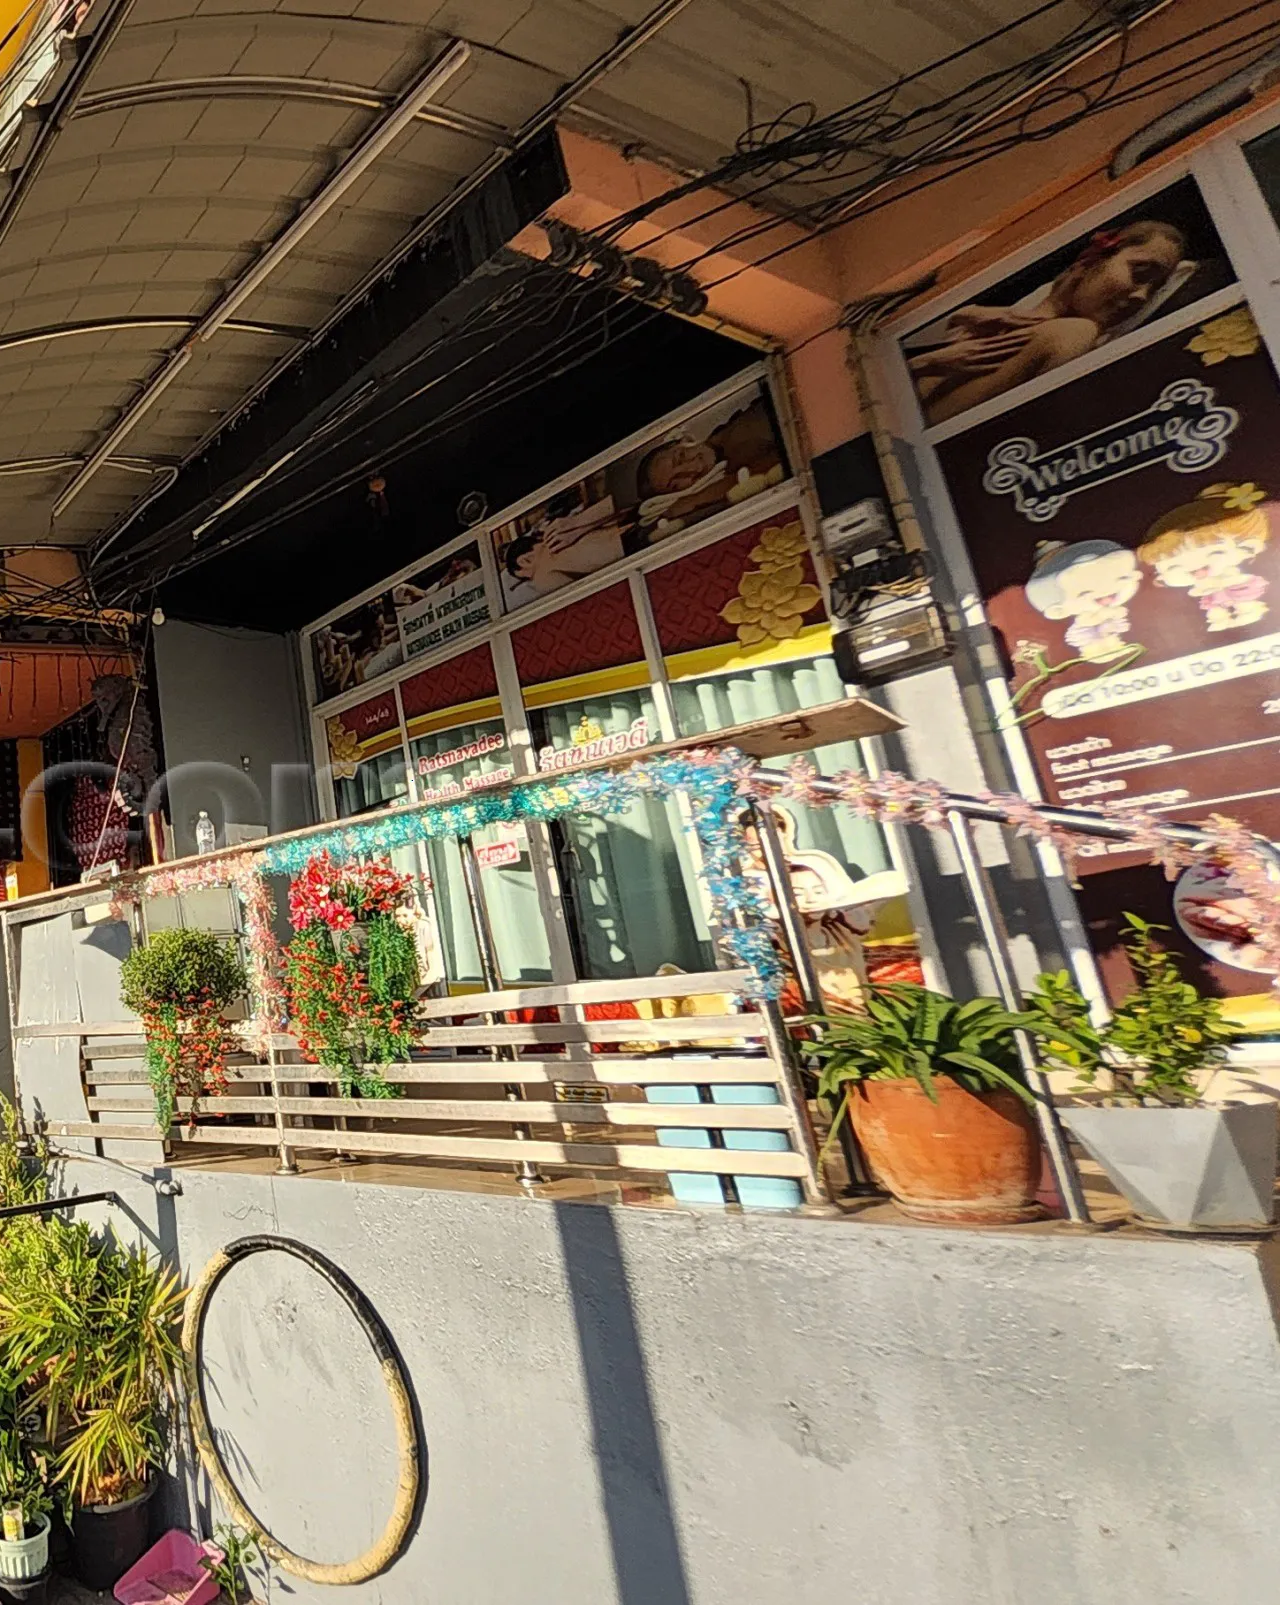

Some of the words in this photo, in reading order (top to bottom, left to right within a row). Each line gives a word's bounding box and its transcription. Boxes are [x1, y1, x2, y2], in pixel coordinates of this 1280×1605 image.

[1026, 416, 1184, 493] Welcome
[462, 605, 490, 628] MASSAGE
[419, 733, 504, 775] Ratsnavadee
[424, 780, 461, 800] Health
[463, 768, 511, 791] Massage
